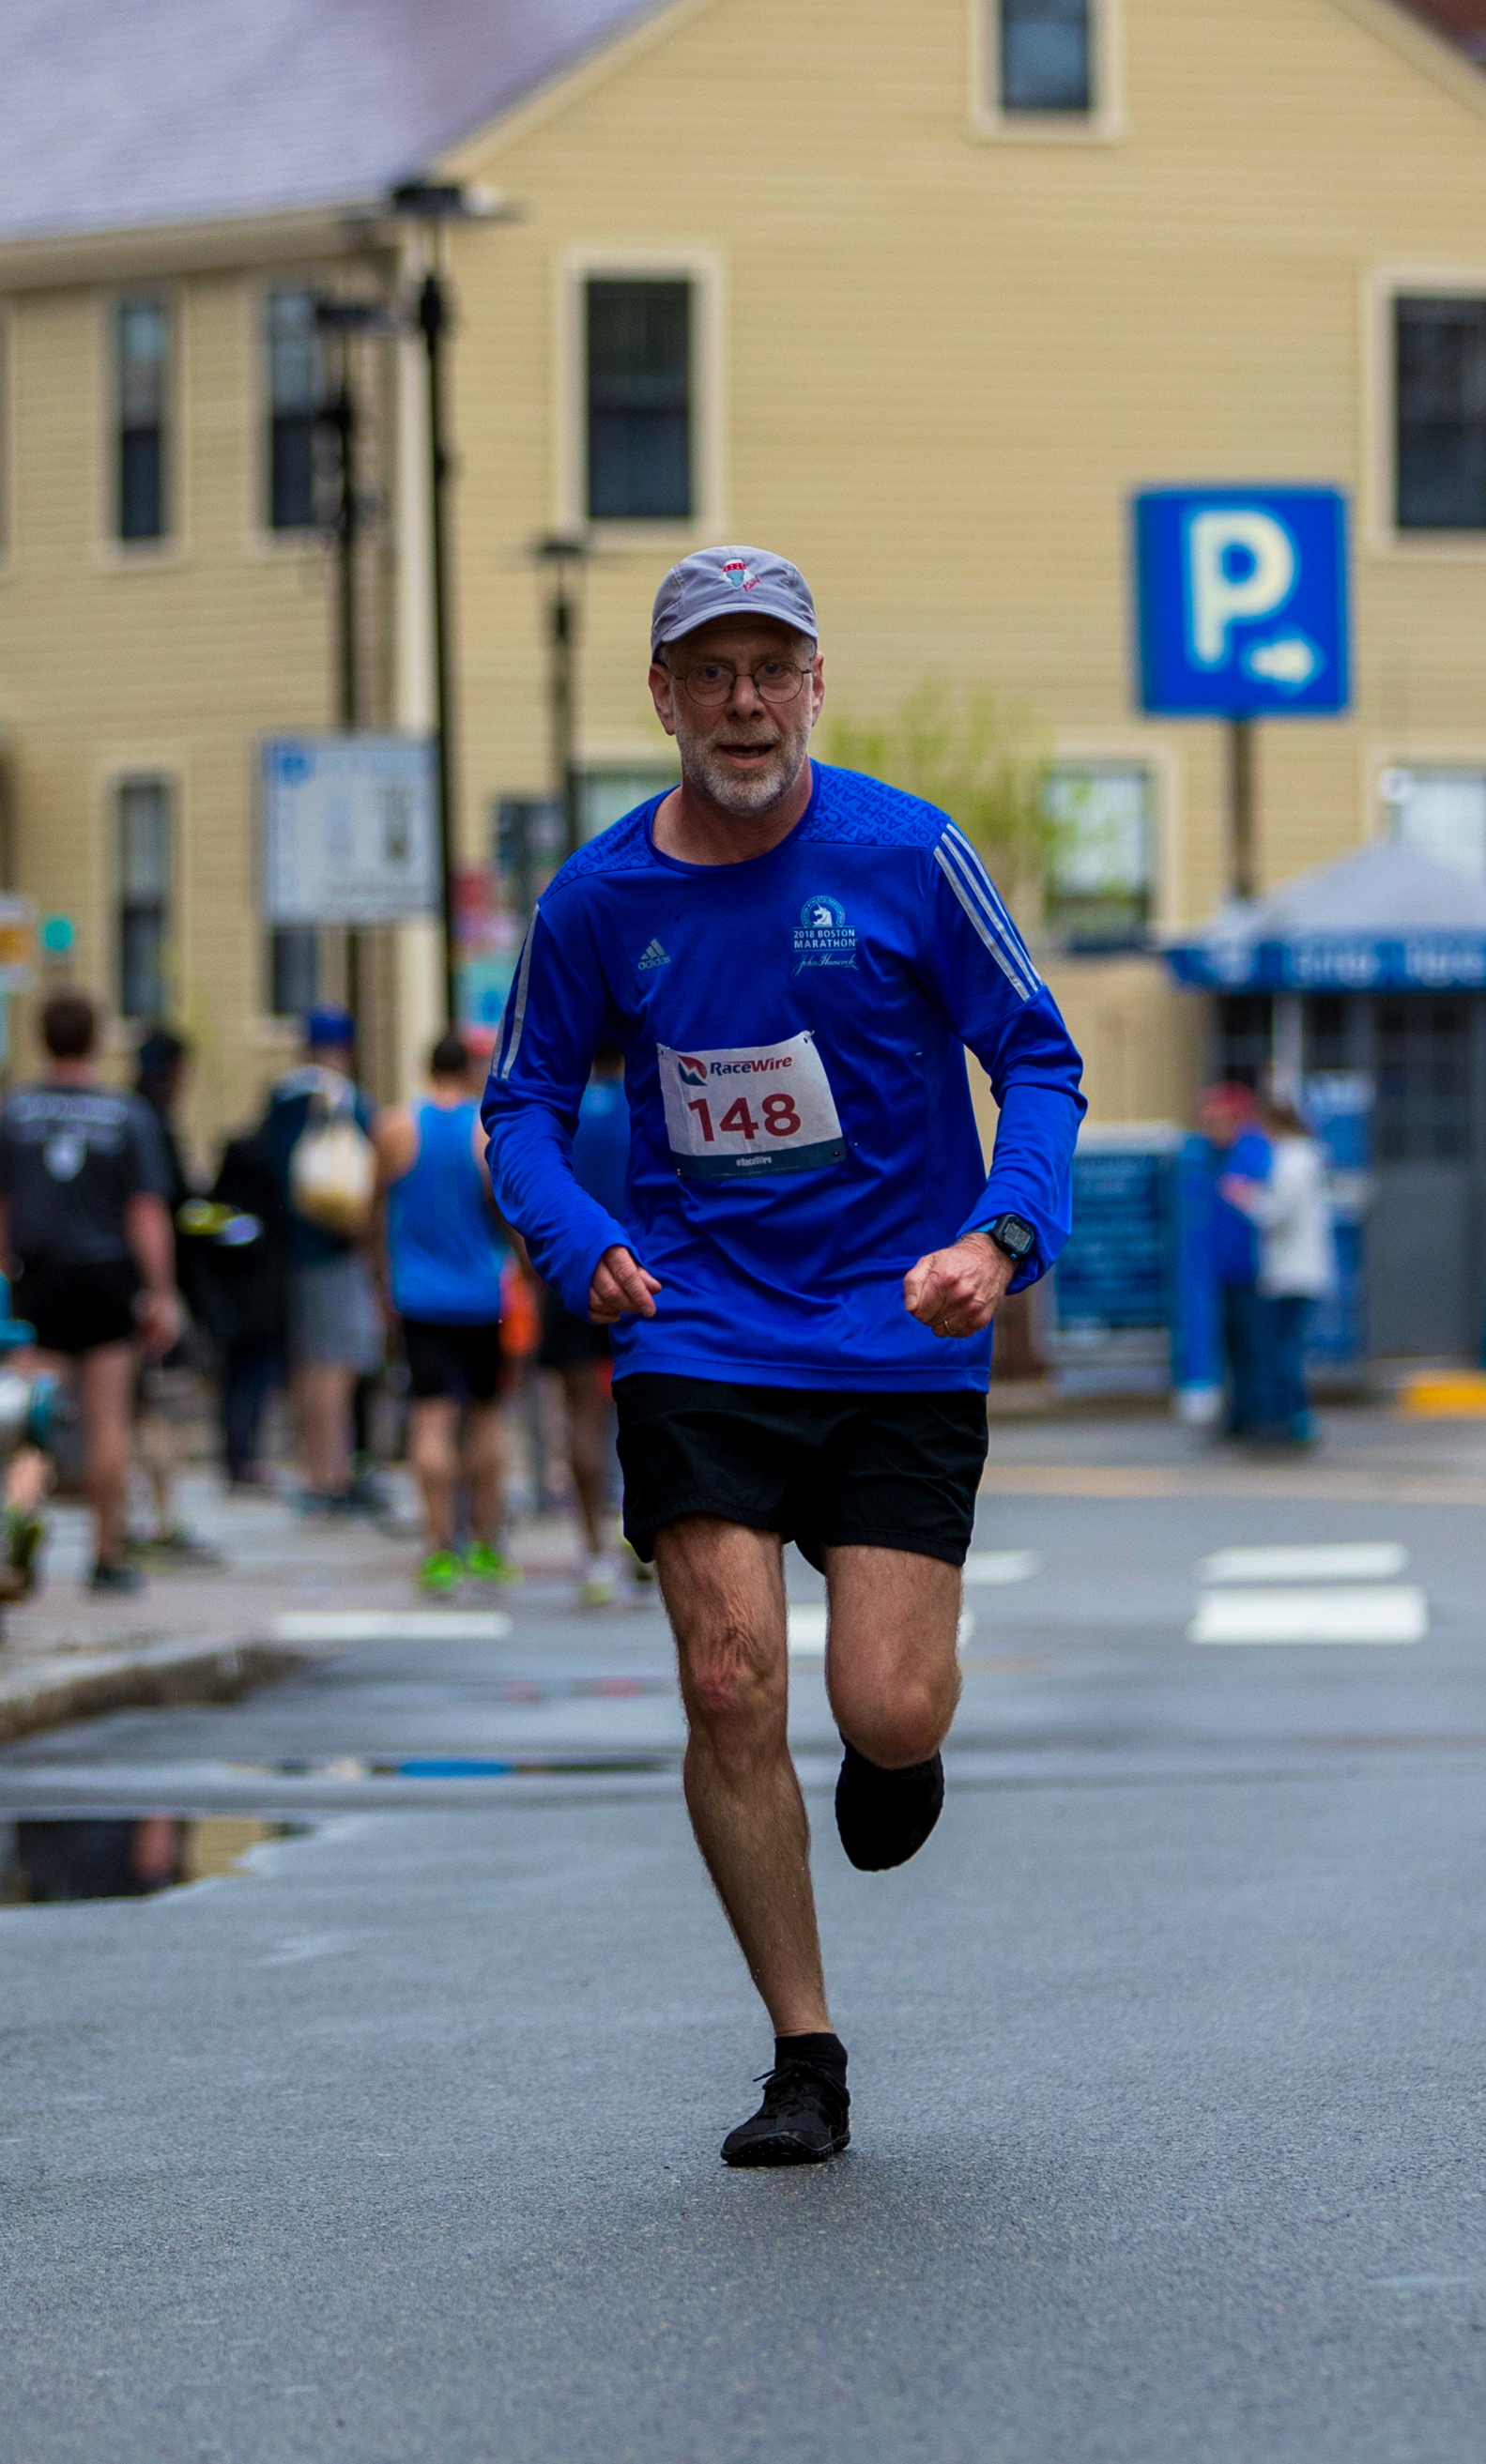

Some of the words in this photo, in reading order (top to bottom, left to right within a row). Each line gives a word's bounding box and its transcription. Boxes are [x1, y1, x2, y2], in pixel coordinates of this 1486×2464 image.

[1187, 510, 1296, 666] P
[820, 773, 904, 831] ASHLAND
[821, 765, 917, 823] FRAMINGHA
[793, 929, 815, 939] 2018
[817, 928, 855, 939] BOSTON
[794, 939, 856, 949] MARATHON
[710, 1056, 793, 1077] RaceWire
[687, 1093, 802, 1142] 148
